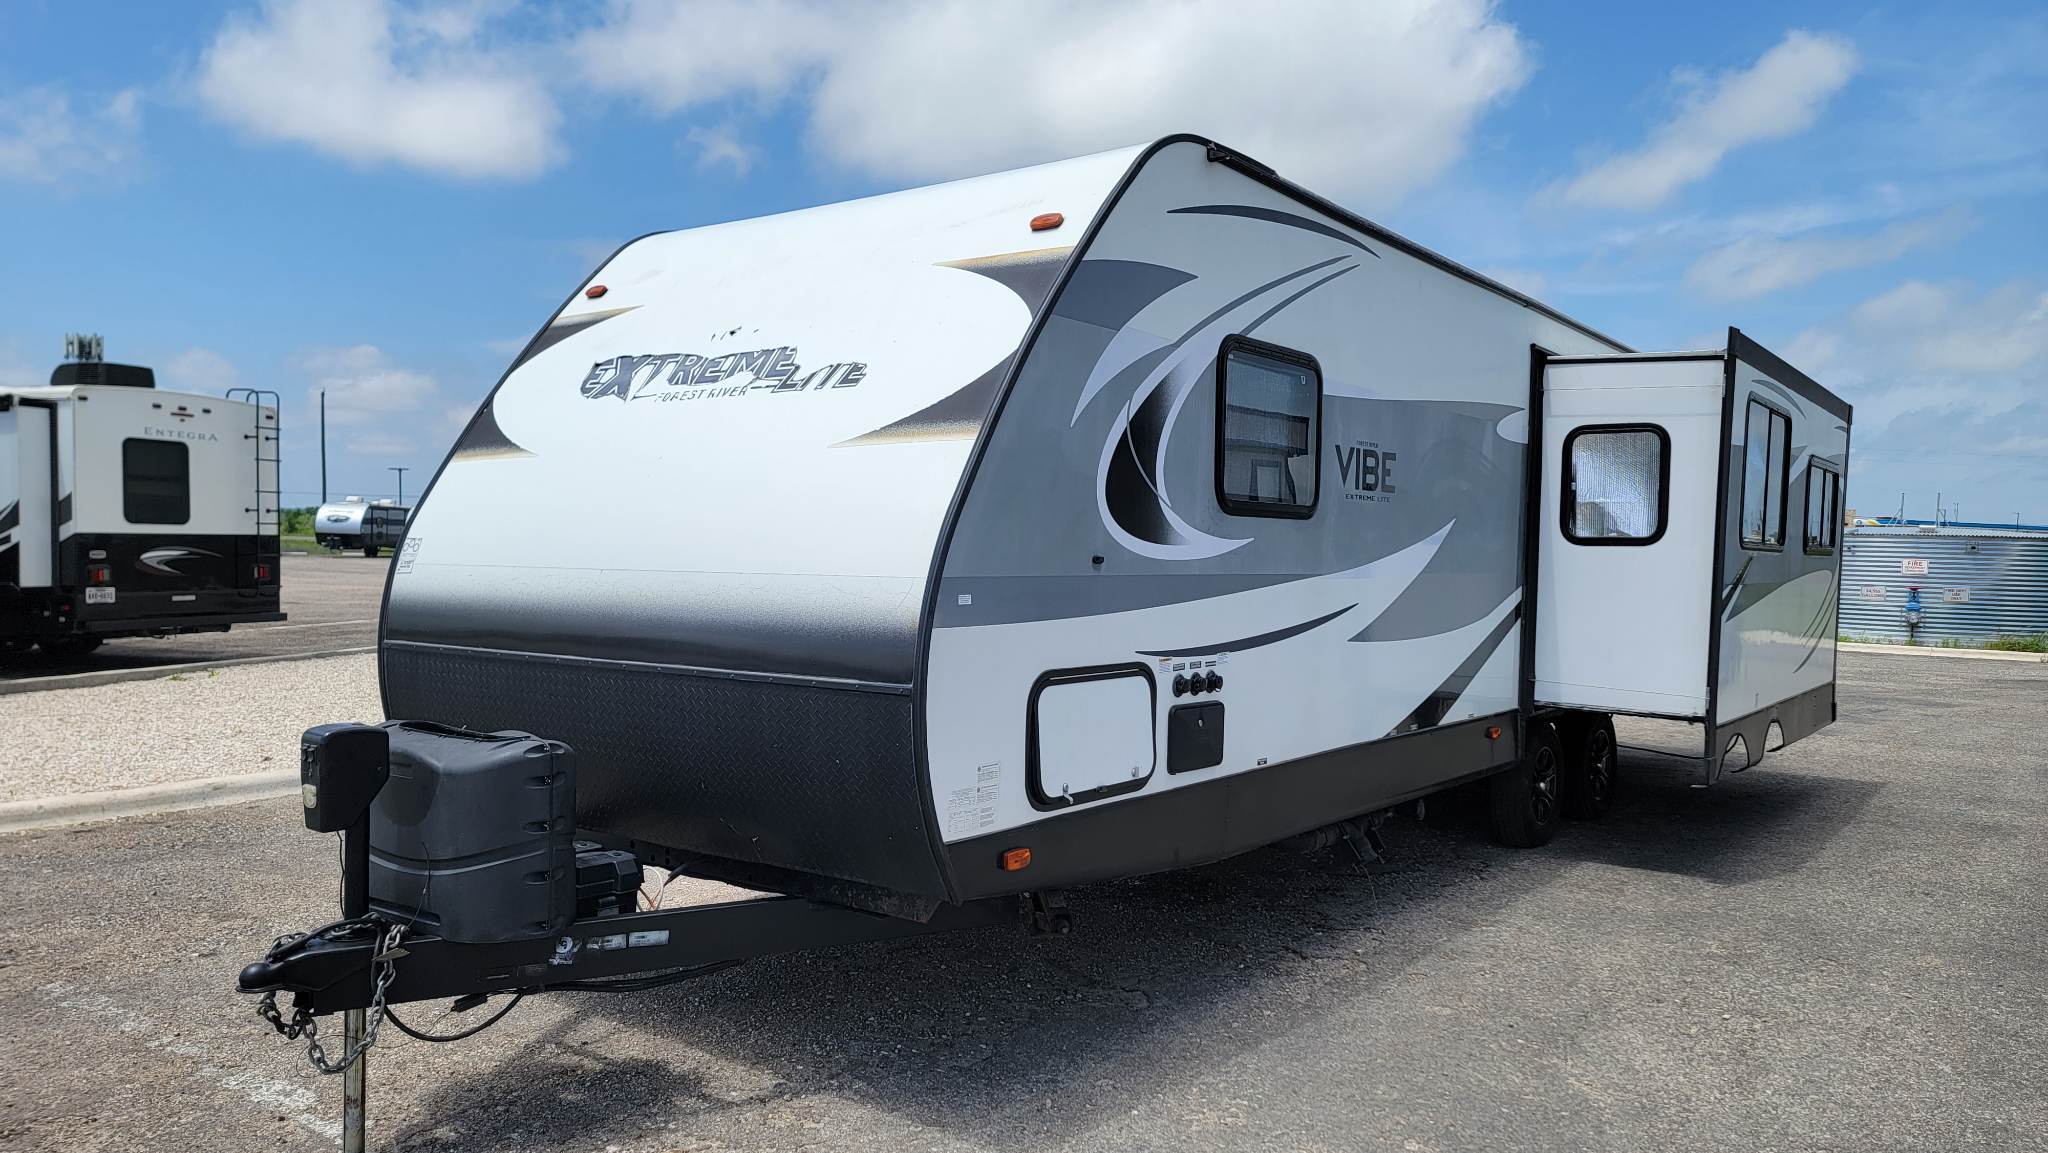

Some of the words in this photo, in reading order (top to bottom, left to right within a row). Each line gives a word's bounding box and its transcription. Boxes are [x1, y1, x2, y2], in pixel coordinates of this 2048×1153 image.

[580, 346, 797, 401] EXTREME
[772, 362, 867, 393] LITE
[1335, 444, 1397, 494] VIBE
[1345, 493, 1376, 502] EXTREME
